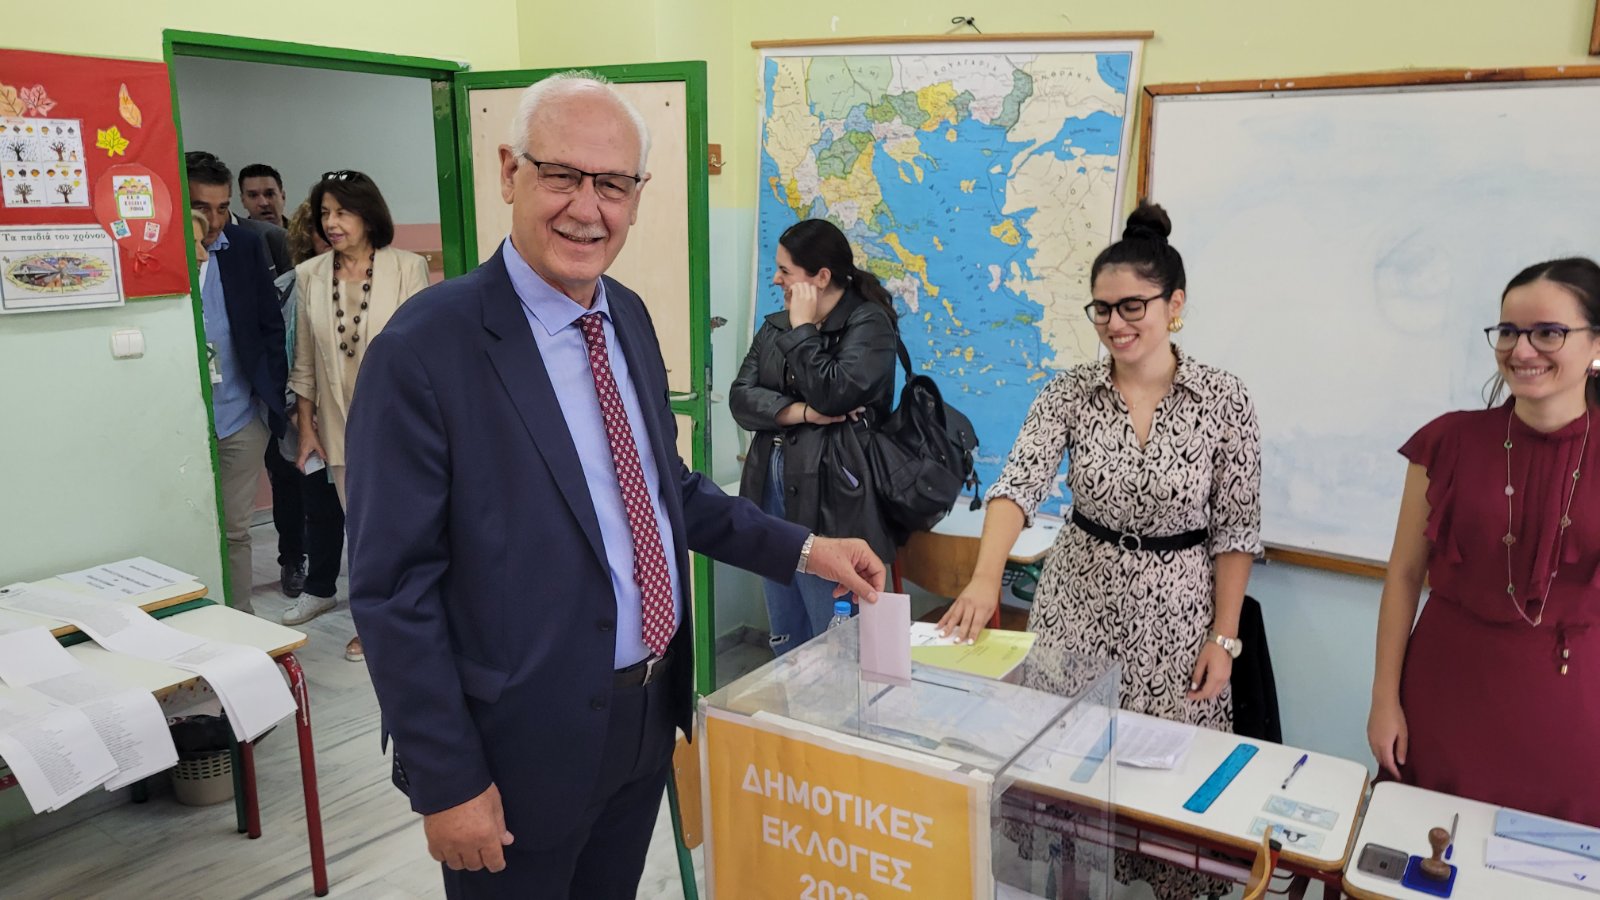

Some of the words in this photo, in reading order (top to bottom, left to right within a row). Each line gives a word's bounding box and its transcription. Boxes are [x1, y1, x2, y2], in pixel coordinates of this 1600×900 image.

[2, 233, 16, 241] Τα
[21, 232, 51, 241] παιδιά
[73, 231, 106, 242] χρόνου
[741, 763, 934, 848] ΔΗΜΟΤΙΚΕΣ
[762, 814, 912, 892] ΕΚΛΟΓΕΣ
[799, 873, 869, 900] 202
